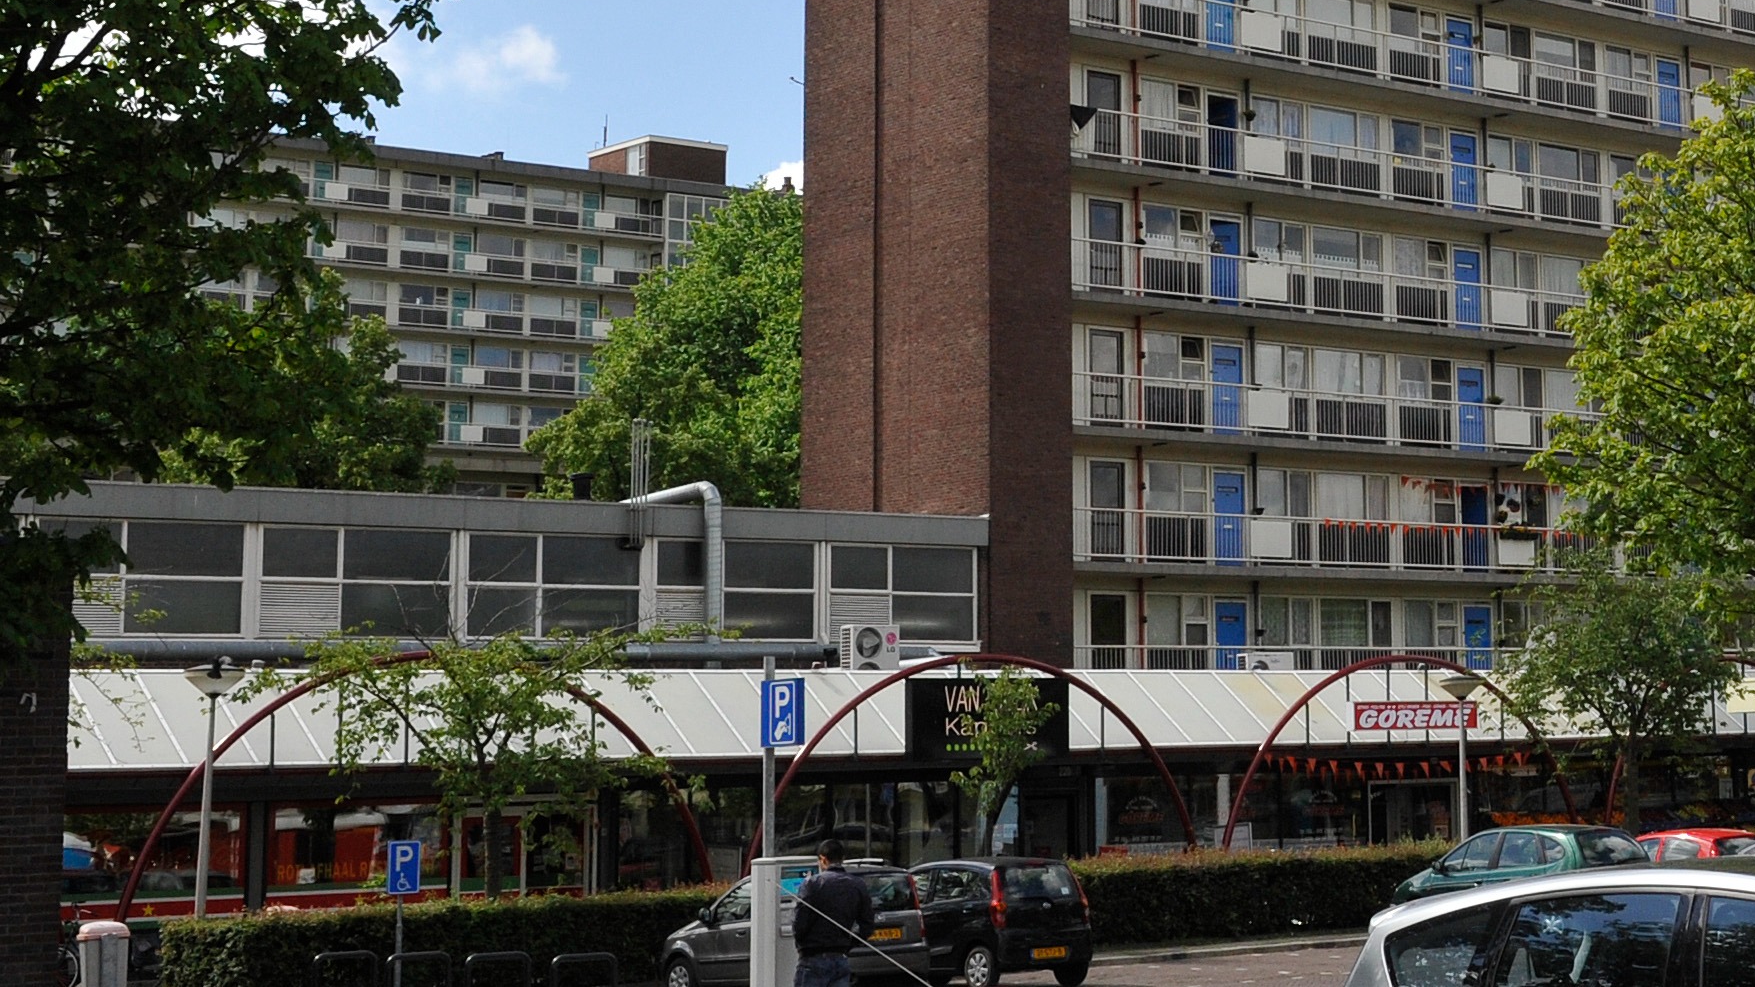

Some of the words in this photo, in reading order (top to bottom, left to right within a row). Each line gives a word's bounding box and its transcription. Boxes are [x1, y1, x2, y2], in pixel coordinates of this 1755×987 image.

[774, 685, 790, 719] P
[945, 686, 981, 713] VAN
[1359, 704, 1472, 728] GÖREME
[396, 845, 413, 872] P
